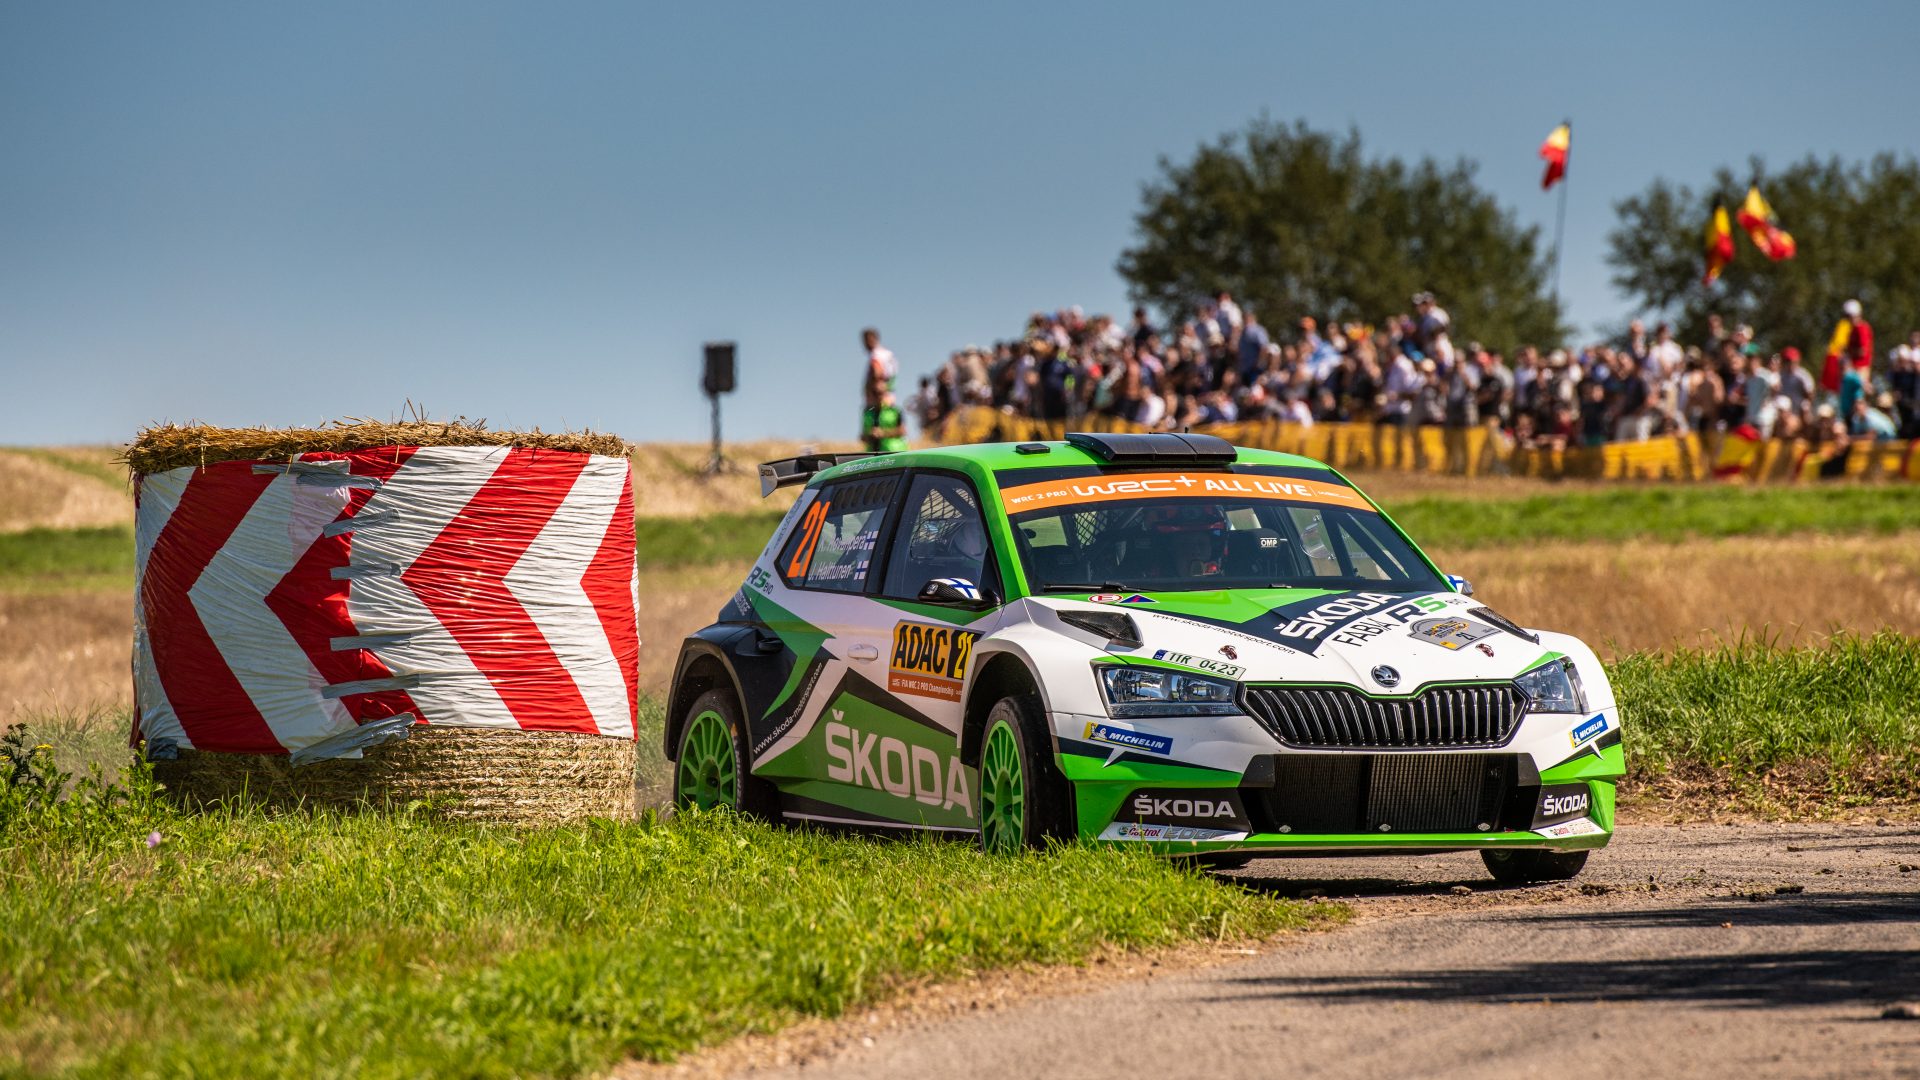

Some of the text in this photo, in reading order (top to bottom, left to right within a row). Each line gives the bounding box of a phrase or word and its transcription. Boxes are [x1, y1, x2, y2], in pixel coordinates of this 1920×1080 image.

[1011, 495, 1035, 504] WRC
[1046, 490, 1068, 498] PRO
[1205, 479, 1252, 492] ALL
[1254, 481, 1312, 497] LIVE
[787, 501, 831, 577] 21
[1260, 538, 1278, 547] OMP
[747, 566, 771, 588] R5
[1273, 592, 1403, 640] ŠKODA
[1386, 597, 1448, 624] R5
[1152, 613, 1296, 655] www.skoda-motorsport.com
[1332, 617, 1401, 647] FABIA
[893, 624, 948, 674] ADAC
[1199, 659, 1239, 676] 0423
[753, 662, 823, 754] www.skoda-motorsport.com
[1109, 732, 1165, 749] MICHELIN
[1579, 719, 1604, 739] MICHELIN
[825, 708, 974, 819] ŠKODA
[1134, 795, 1236, 818] ŠKODA
[1543, 794, 1588, 816] ŠKODA
